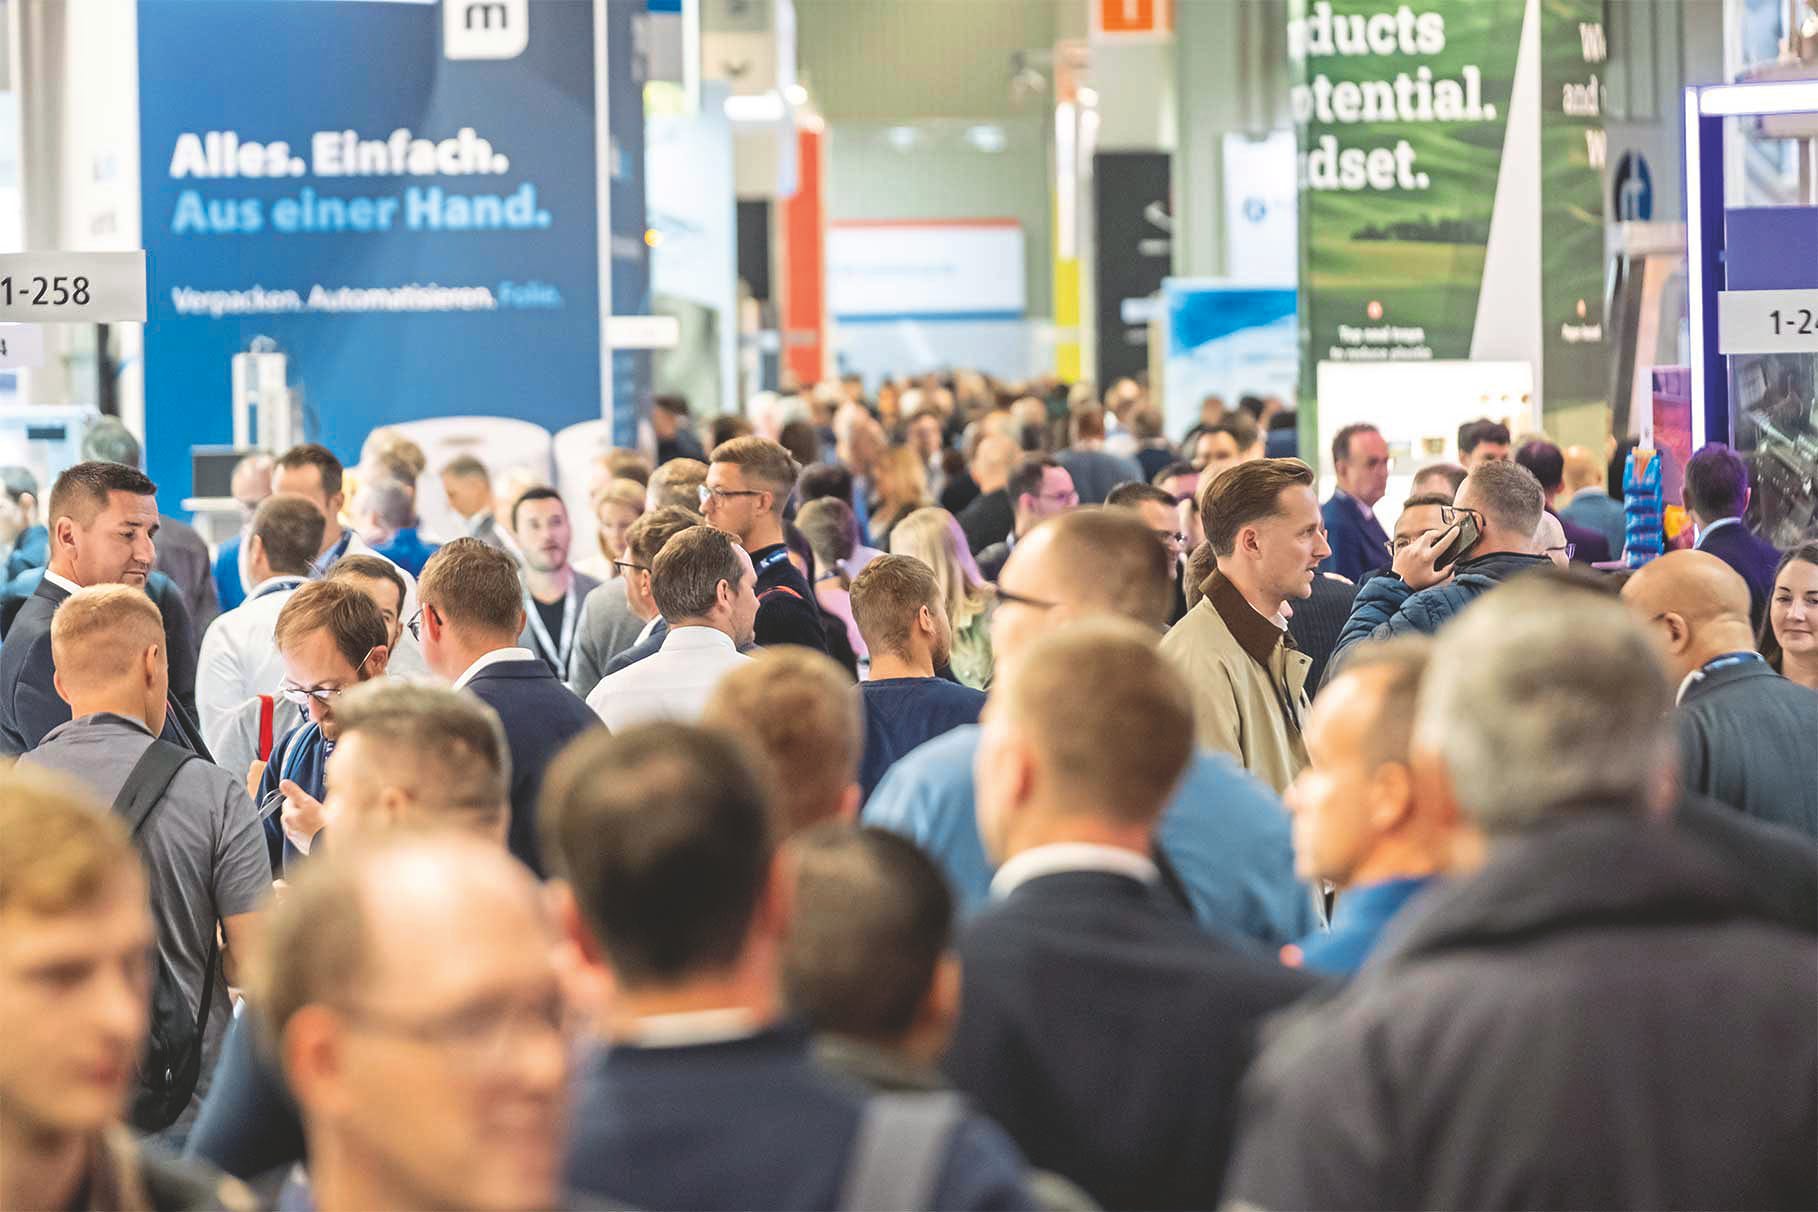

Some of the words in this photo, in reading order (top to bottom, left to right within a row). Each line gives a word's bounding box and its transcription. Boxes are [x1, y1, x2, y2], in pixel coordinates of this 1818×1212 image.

[170, 130, 305, 178] Alles.
[312, 127, 509, 176] Einfach.
[171, 189, 263, 234] Aus
[271, 185, 399, 232] einer
[405, 182, 552, 230] Hand.
[1, 276, 90, 306] 1-258
[170, 283, 305, 319] Verpacken.
[307, 281, 497, 313] Automatisieren.
[1770, 308, 1818, 335] 1-2
